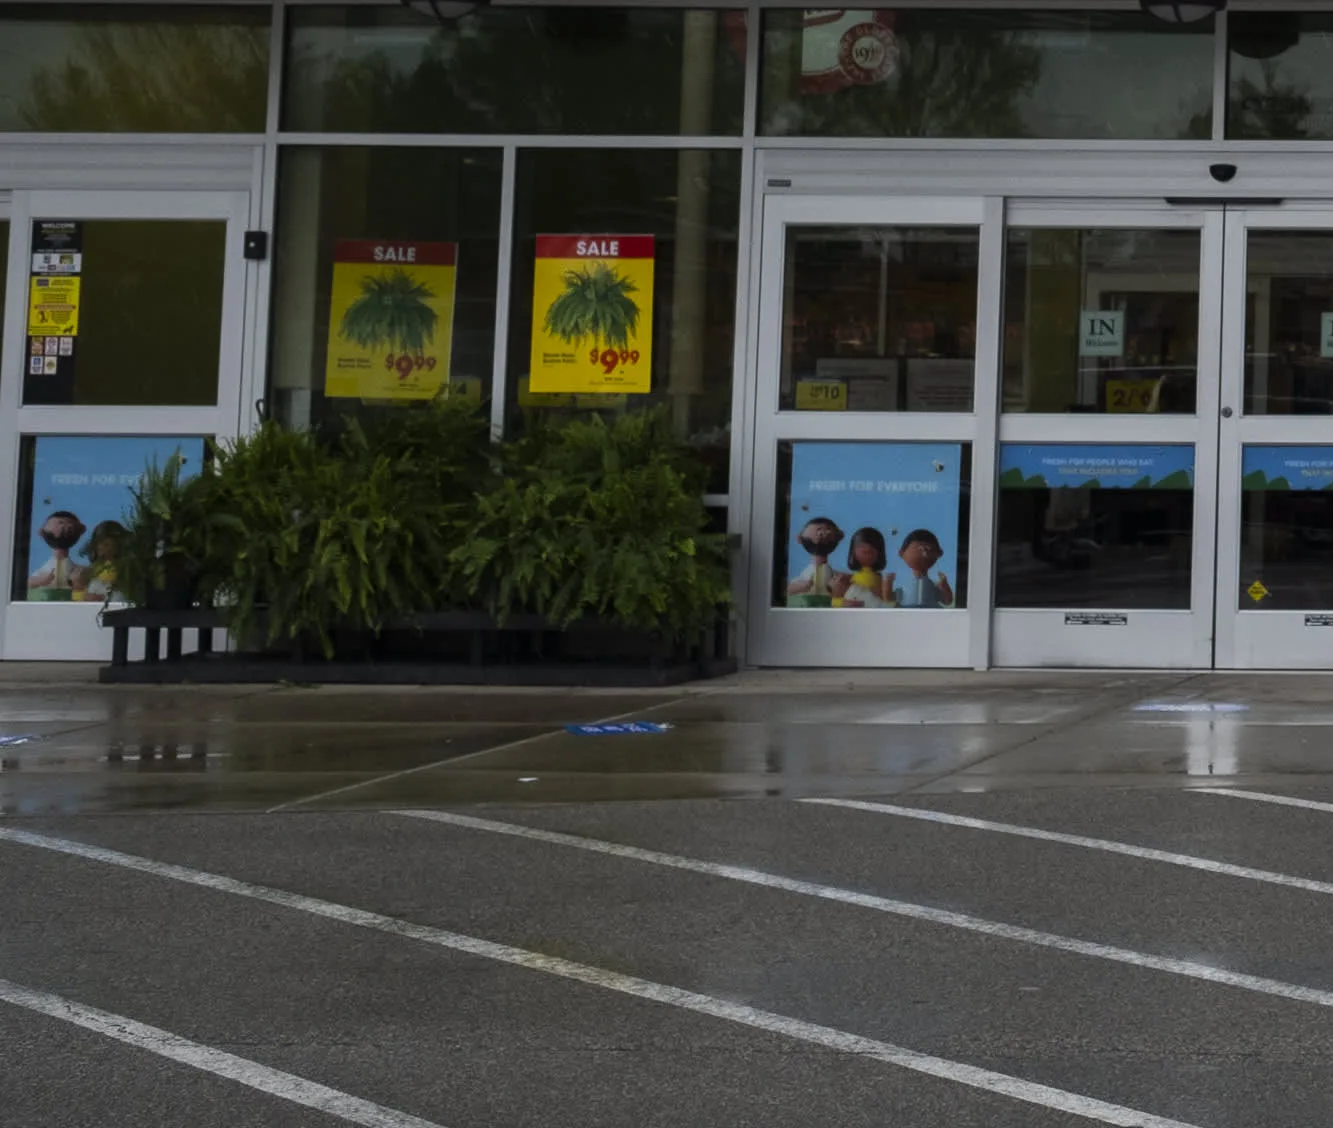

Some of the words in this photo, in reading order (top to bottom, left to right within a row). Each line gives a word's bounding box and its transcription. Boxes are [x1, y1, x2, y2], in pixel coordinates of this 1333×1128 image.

[373, 246, 416, 262] SALE
[575, 240, 619, 256] SALE
[1088, 318, 1115, 336] IN
[849, 480, 873, 491] FOR
